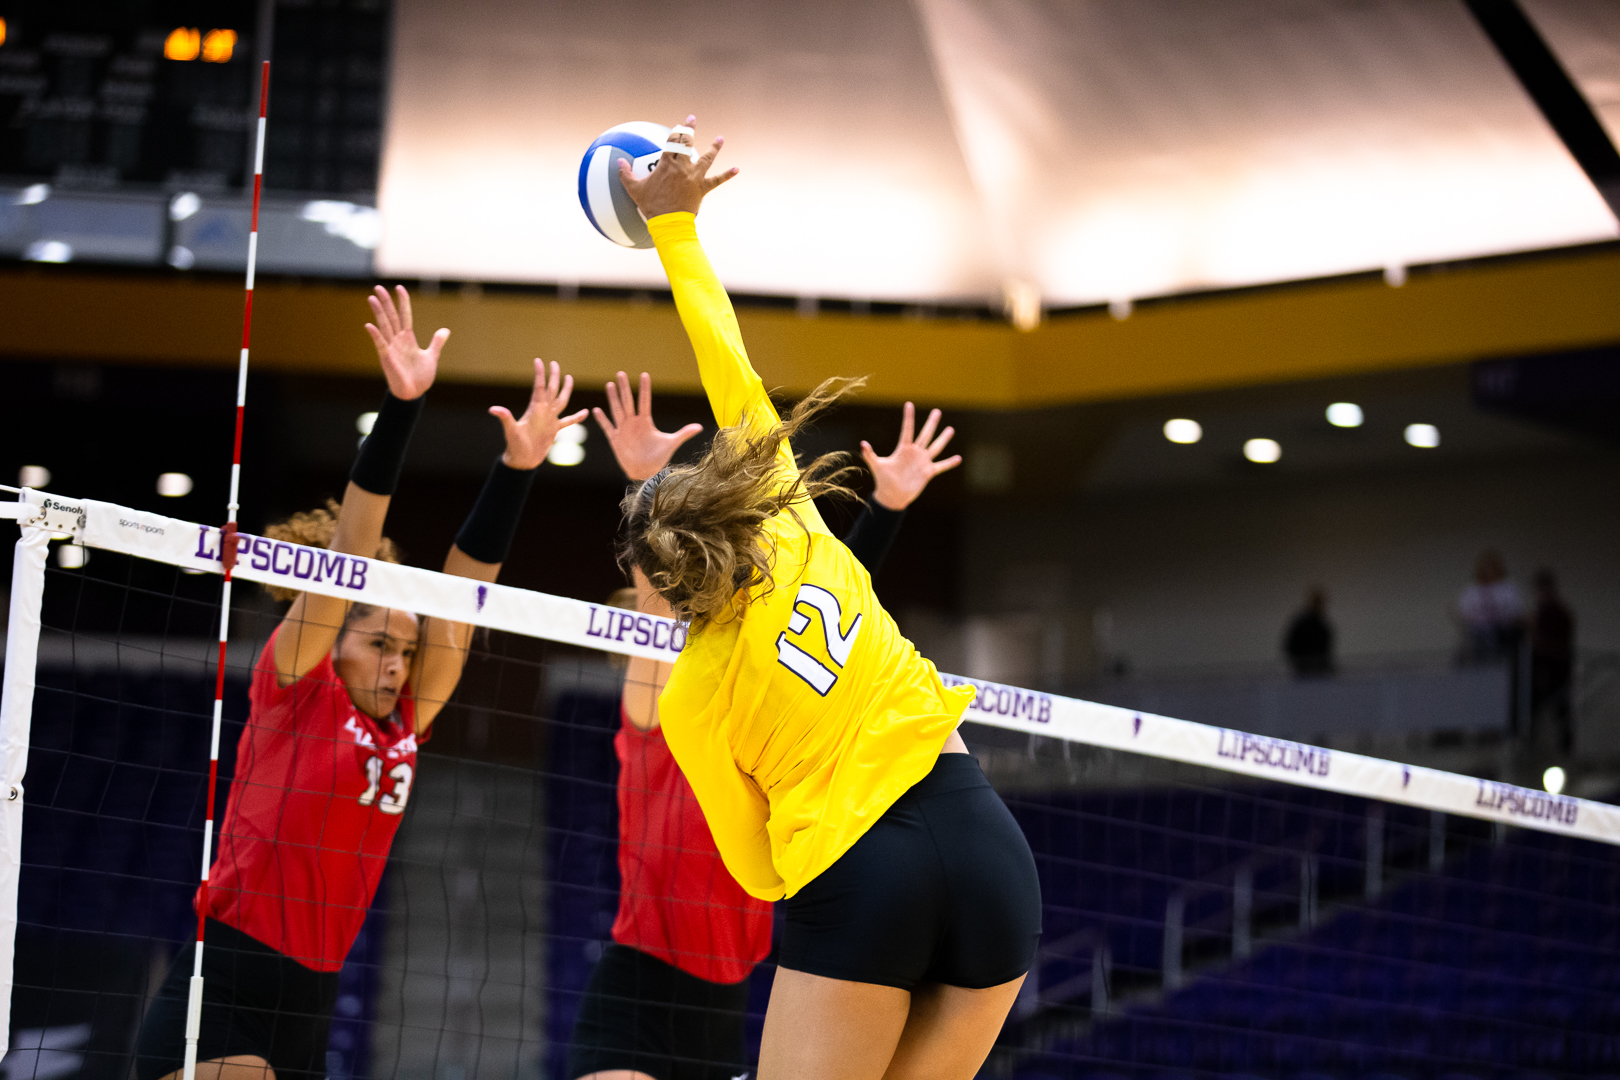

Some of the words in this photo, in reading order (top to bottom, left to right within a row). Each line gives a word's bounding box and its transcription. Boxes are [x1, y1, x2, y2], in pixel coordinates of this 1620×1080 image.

[53, 501, 83, 514] Senoh
[775, 583, 863, 697] 12
[1217, 728, 1330, 776] LIPSCOMB
[358, 756, 413, 815] 13
